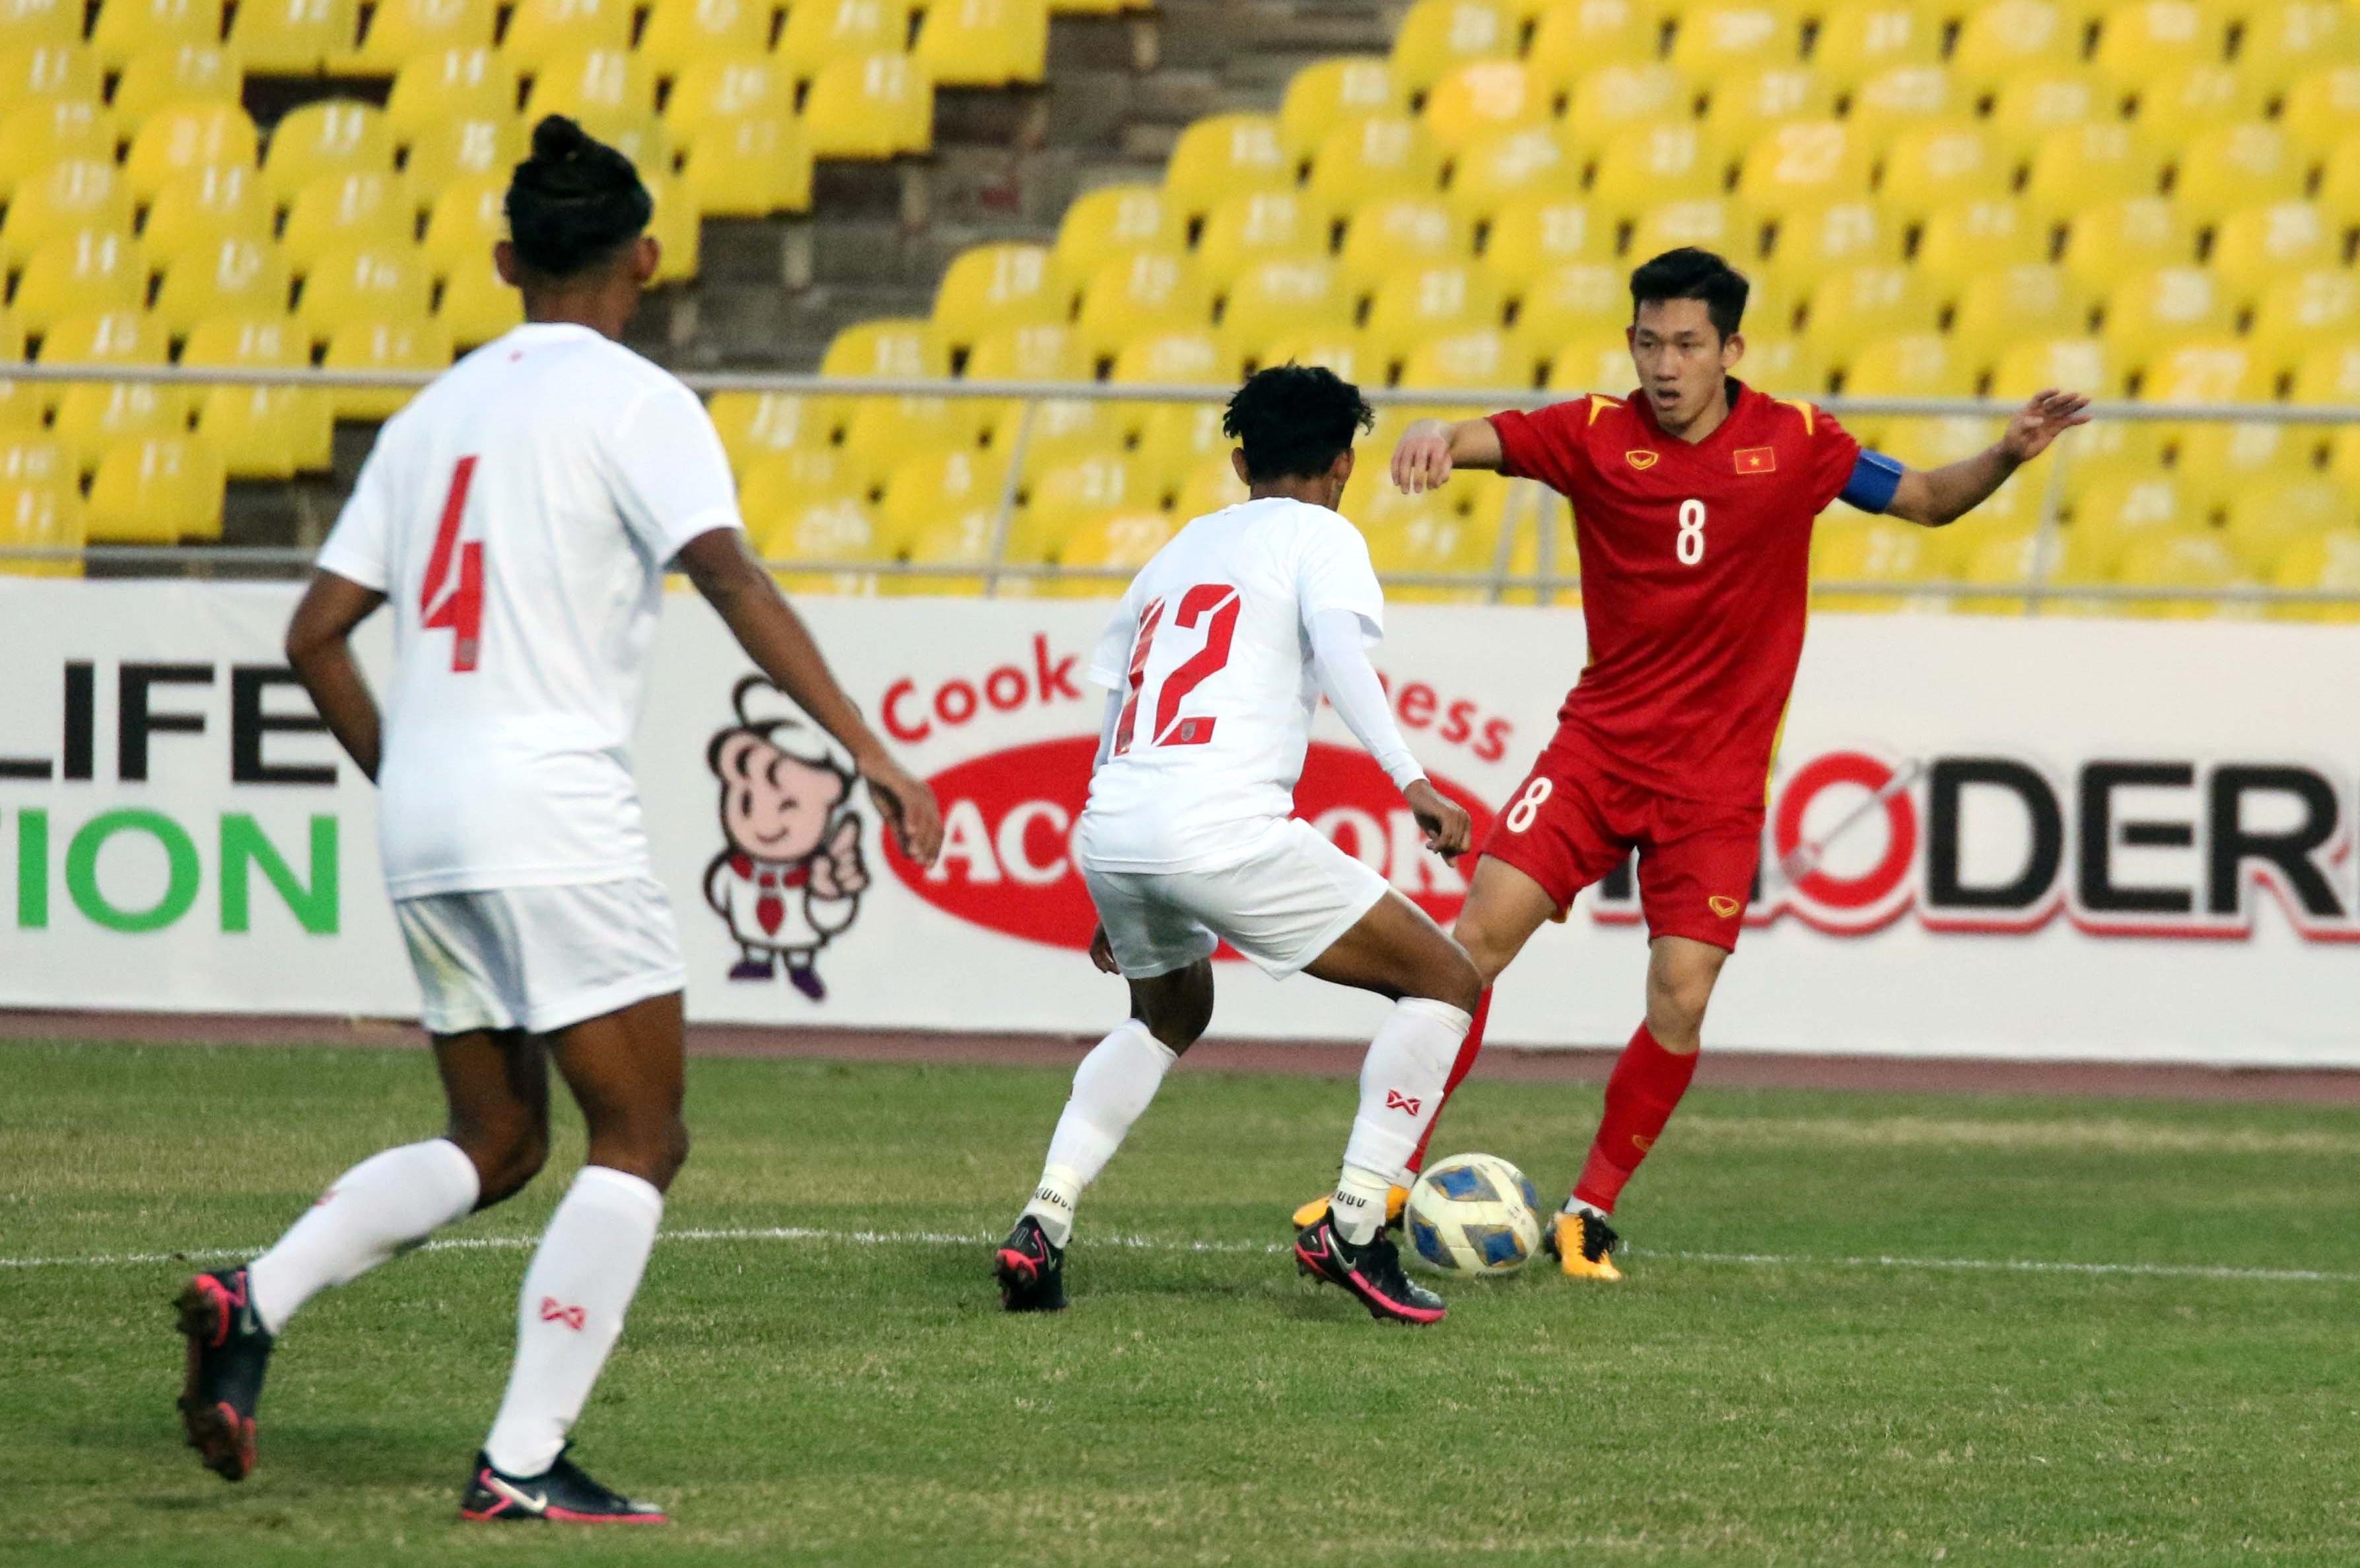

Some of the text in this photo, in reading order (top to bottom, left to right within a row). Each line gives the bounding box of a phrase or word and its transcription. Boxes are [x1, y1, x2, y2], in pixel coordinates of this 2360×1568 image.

[420, 456, 482, 672] 4
[1676, 499, 1706, 566] 8
[882, 632, 1083, 743] Cook
[1114, 584, 1240, 757] 12
[1506, 776, 1553, 833] 8
[0, 807, 339, 934] ION
